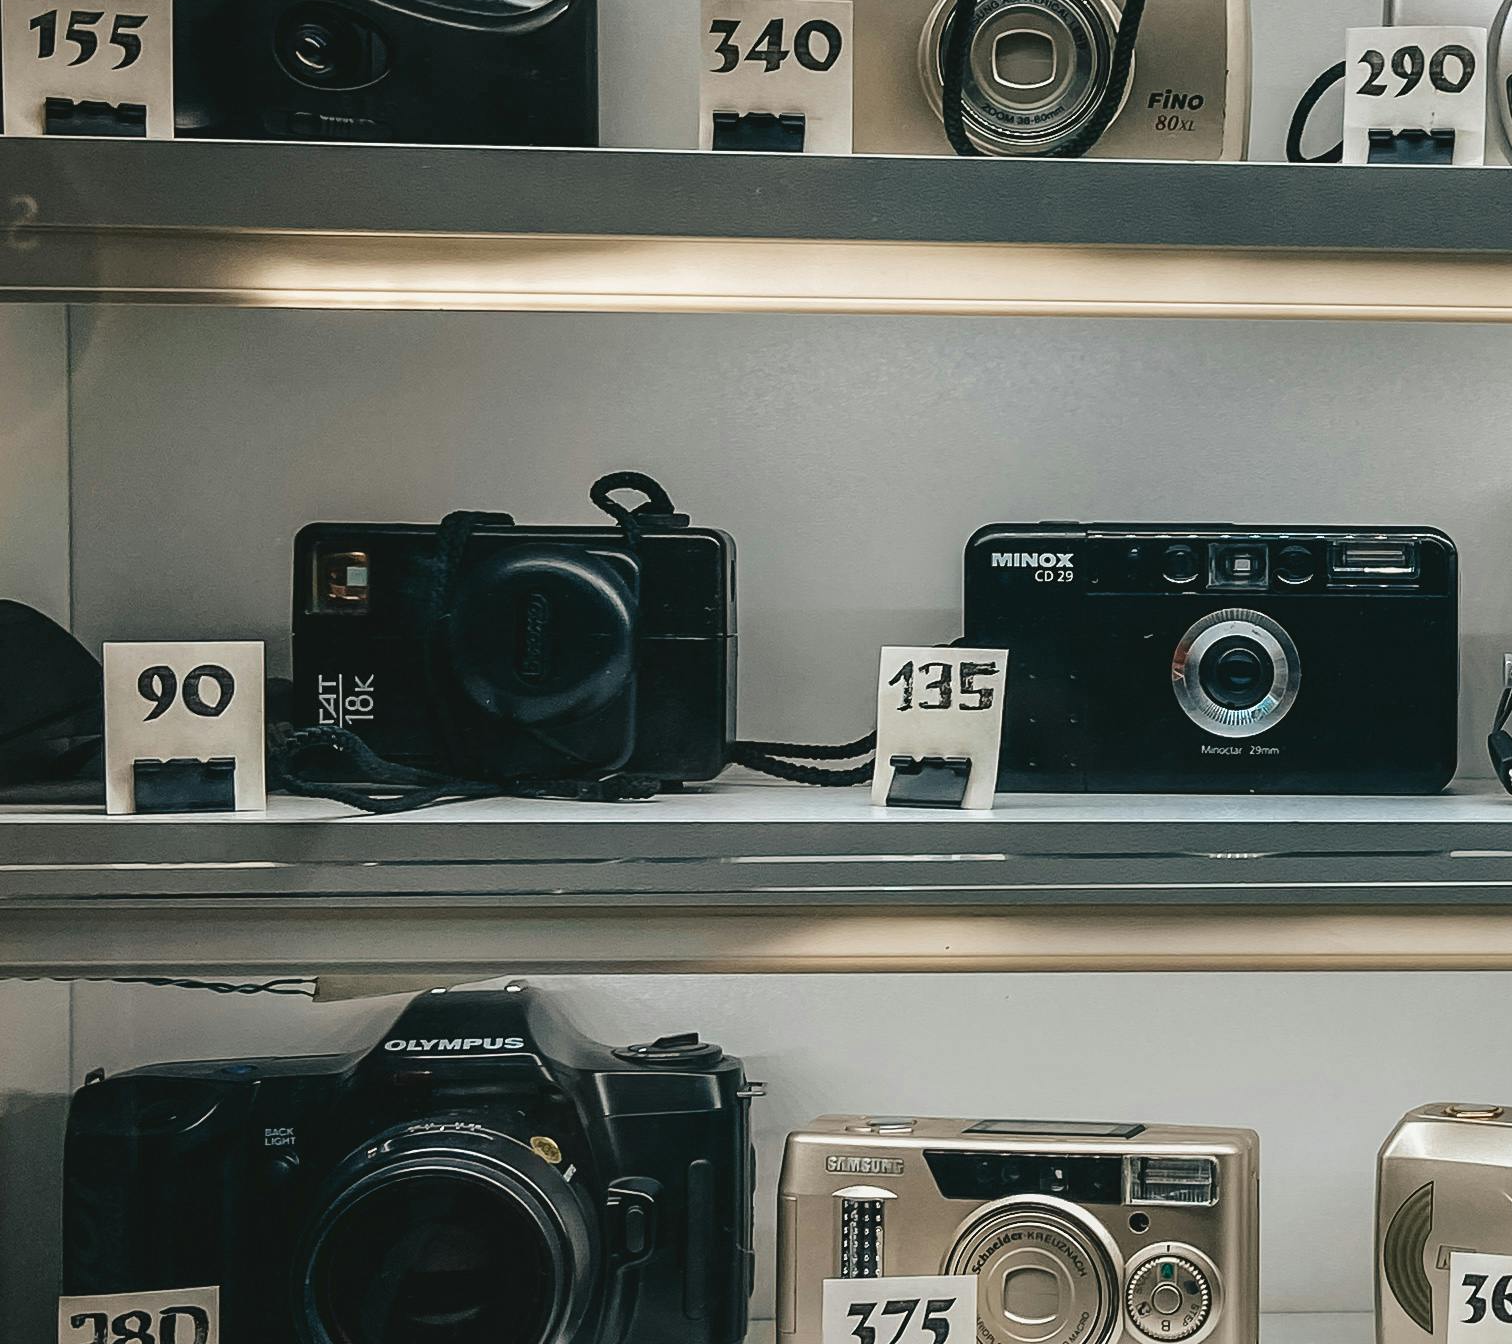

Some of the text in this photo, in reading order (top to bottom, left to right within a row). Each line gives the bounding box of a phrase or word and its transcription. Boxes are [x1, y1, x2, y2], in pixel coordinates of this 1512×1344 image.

[28, 9, 151, 70] 155
[708, 17, 844, 73] 340
[1357, 44, 1476, 98] 290
[991, 552, 1075, 568] MINOX
[1034, 570, 1075, 583] CD 29
[137, 664, 236, 723] 90
[887, 659, 1002, 713] 135
[1249, 744, 1280, 756] 29mm
[384, 1036, 526, 1053] OLYMPUS
[264, 1127, 295, 1137] BACK
[264, 1137, 296, 1146] LIGHT
[826, 1155, 905, 1175] SAMSUNG
